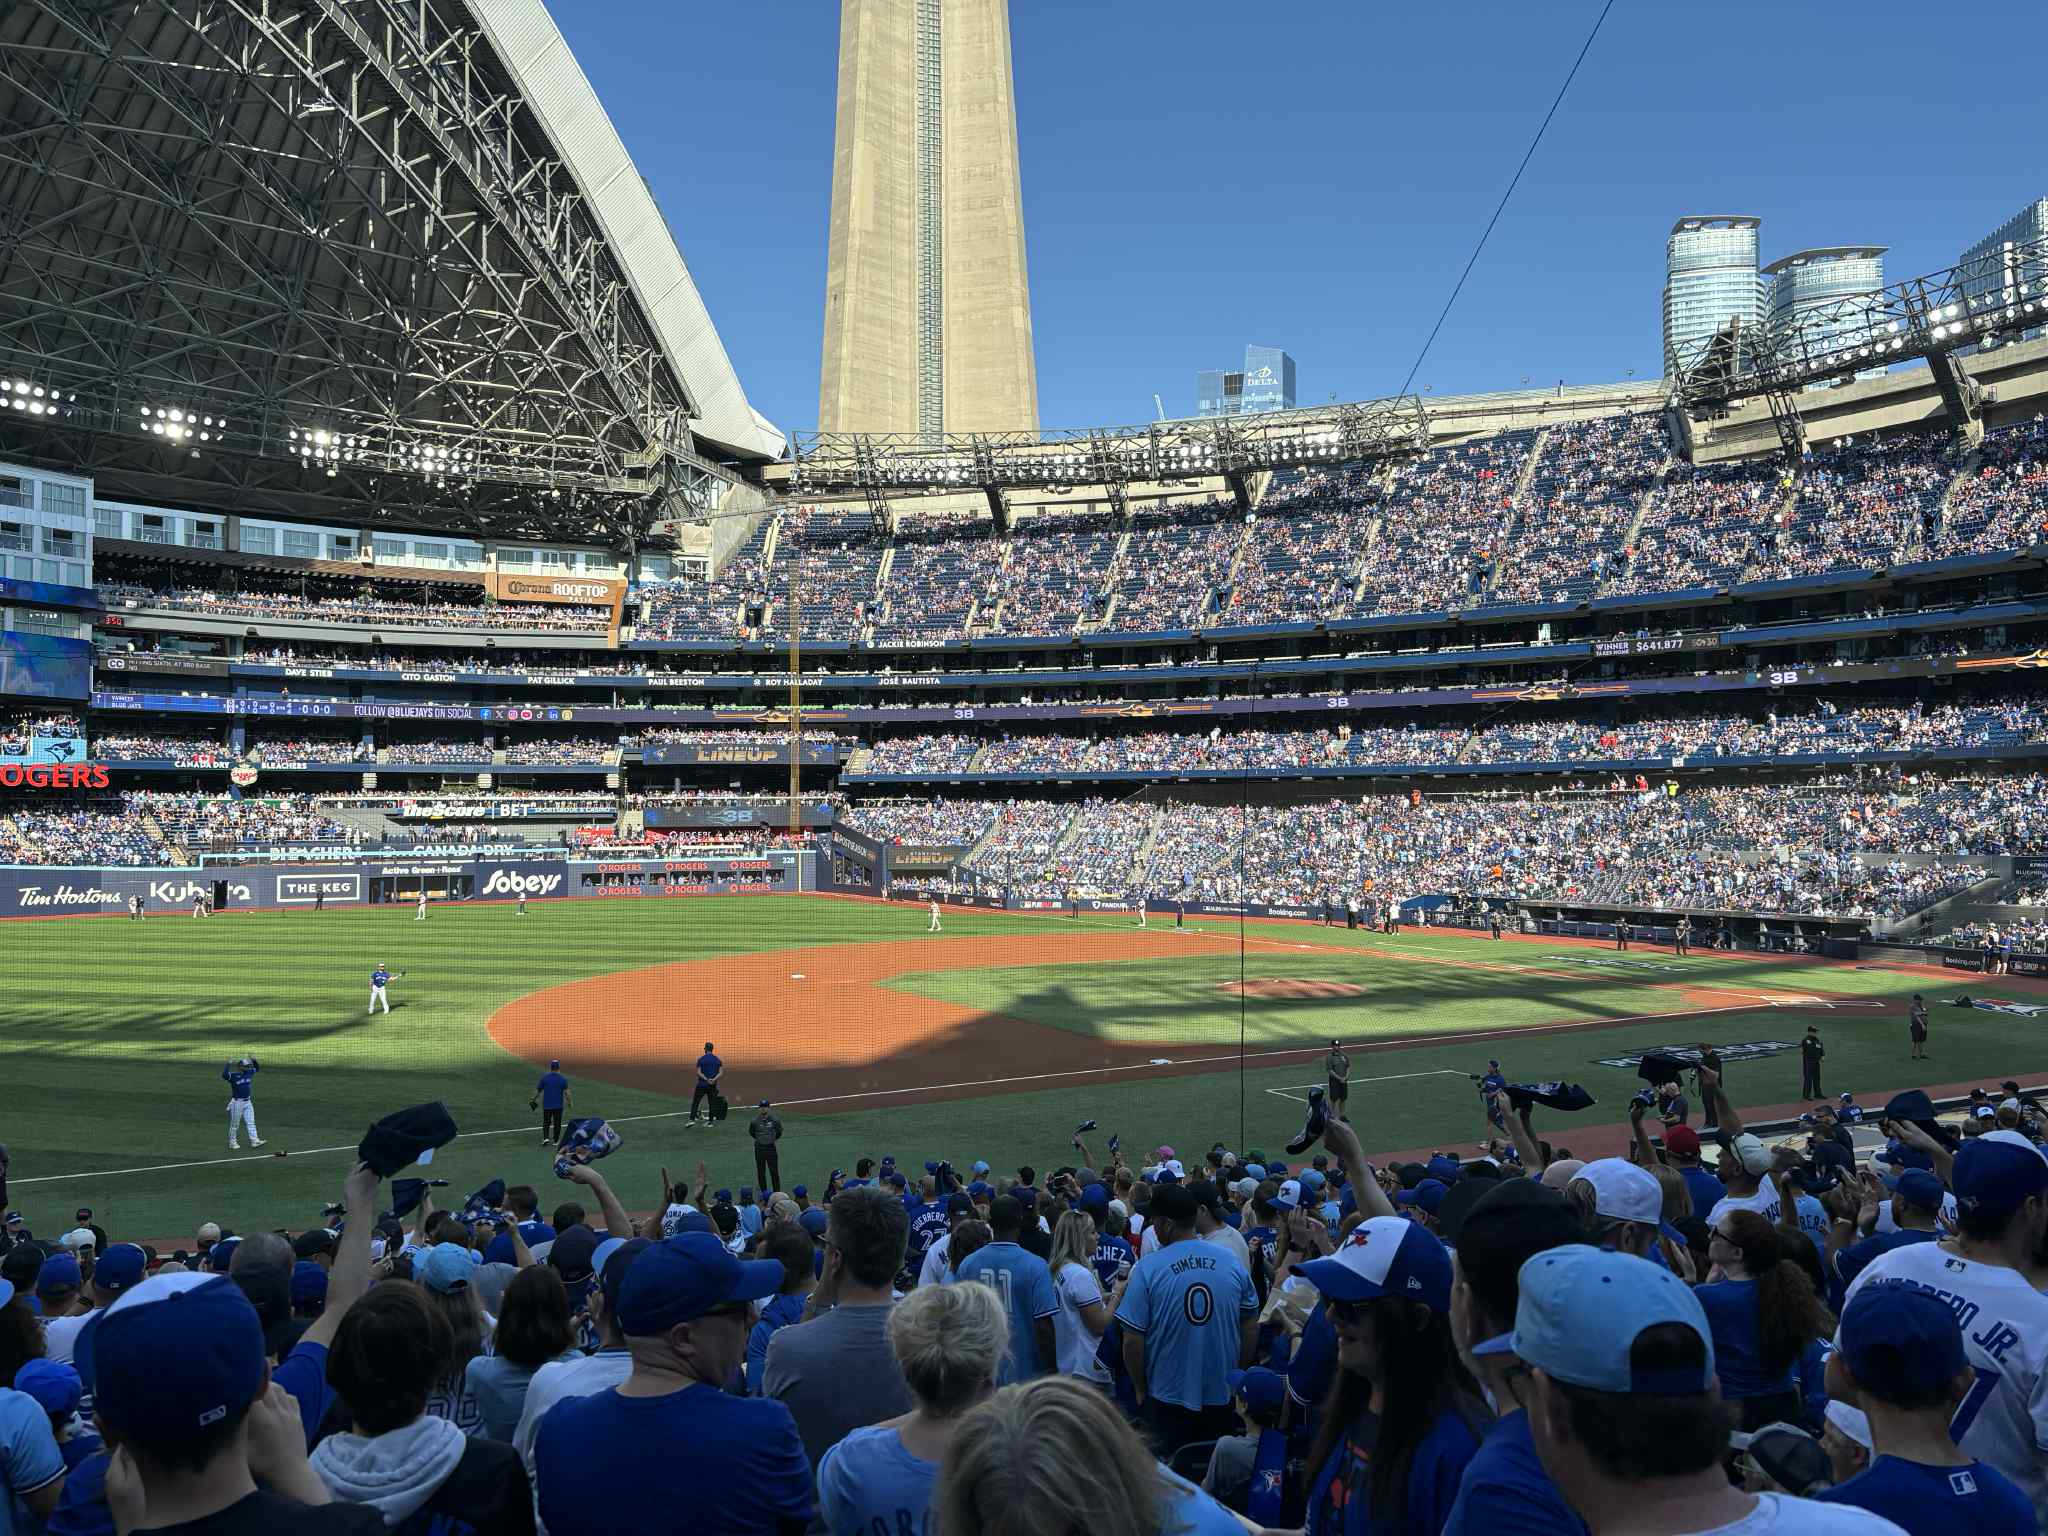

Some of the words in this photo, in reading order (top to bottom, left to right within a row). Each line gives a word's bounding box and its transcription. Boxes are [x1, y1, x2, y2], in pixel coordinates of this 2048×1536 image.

[508, 580, 552, 595] Corona
[553, 584, 608, 598] ROOFTOP
[878, 640, 904, 648] JACKIE
[906, 639, 945, 648] ROBINSON
[1595, 641, 1629, 651] WINNER
[1636, 639, 1683, 652] $641,877
[108, 658, 125, 669] CC
[285, 668, 307, 677] DAVE
[309, 669, 333, 678] STIEB
[401, 673, 421, 681] CITO
[423, 674, 456, 682] GASTON
[1769, 670, 1799, 686] 3B
[527, 677, 542, 685] PAT
[544, 677, 575, 685] GILLICK
[878, 677, 899, 685] JOSÉ
[1327, 697, 1350, 708] 3B
[354, 705, 386, 716] FOLLOW
[388, 706, 433, 718] @BLUEJAYS
[435, 708, 446, 718] ON
[447, 708, 473, 719] SOCIAL
[954, 709, 975, 719] 3B
[697, 751, 778, 762] LINEUP
[175, 761, 214, 769] CANADA
[403, 804, 486, 817] theScore
[500, 803, 529, 817] BET
[608, 864, 642, 872] ROGERS
[675, 863, 708, 871] ROGERS
[740, 861, 772, 870] ROGERS
[382, 867, 410, 875] Active
[482, 869, 562, 895] Sobeys
[740, 883, 772, 891] ROGERS
[150, 881, 253, 903] Kuba
[288, 883, 317, 894] THE
[324, 882, 352, 893] KEG
[608, 887, 642, 895] ROGERS
[675, 885, 706, 893] ROGERS
[18, 887, 51, 906] Tim
[53, 885, 121, 905] Hortons
[1268, 908, 1308, 918] Booking.com
[1945, 957, 1981, 967] Booking.com
[911, 1210, 945, 1233] GUERRERO
[1170, 1254, 1217, 1275] GIMÉNEZ
[1183, 1281, 1214, 1327] 0
[1972, 1320, 2019, 1364] JR.
